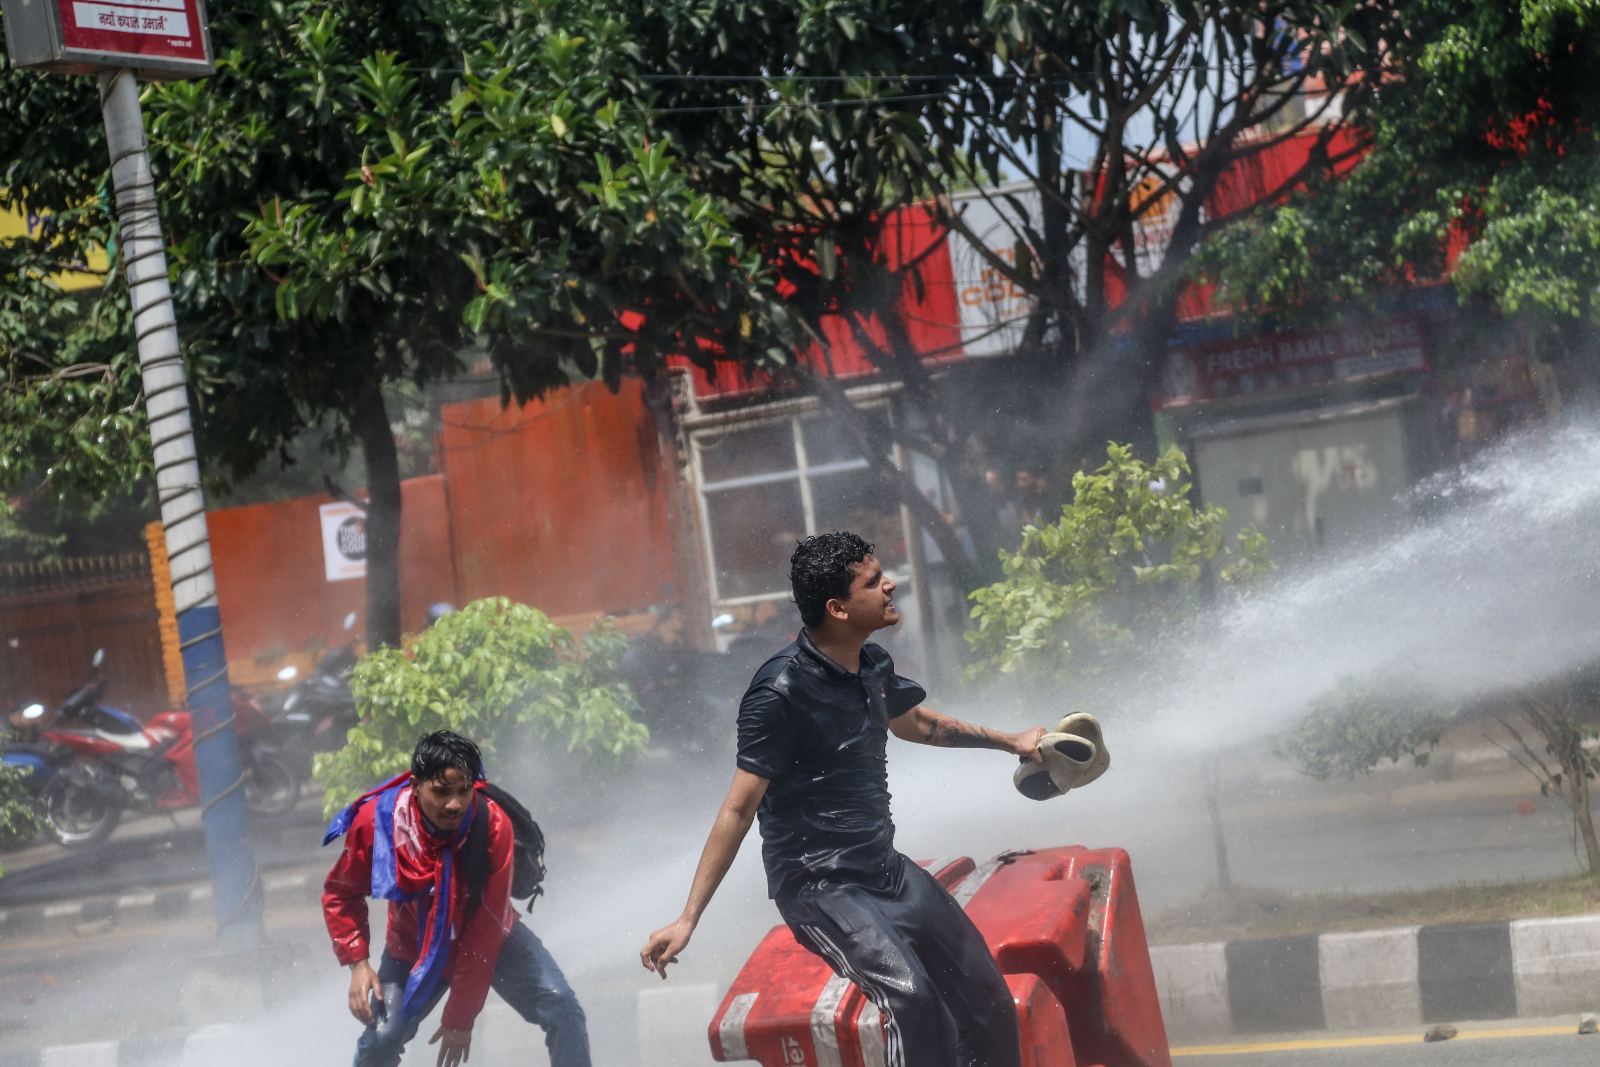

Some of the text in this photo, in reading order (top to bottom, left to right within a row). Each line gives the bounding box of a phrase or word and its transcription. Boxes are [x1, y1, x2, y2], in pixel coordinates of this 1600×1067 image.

[116, 15, 140, 29] कपाल
[1207, 321, 1418, 373] FRESH BAKE HOUSE
